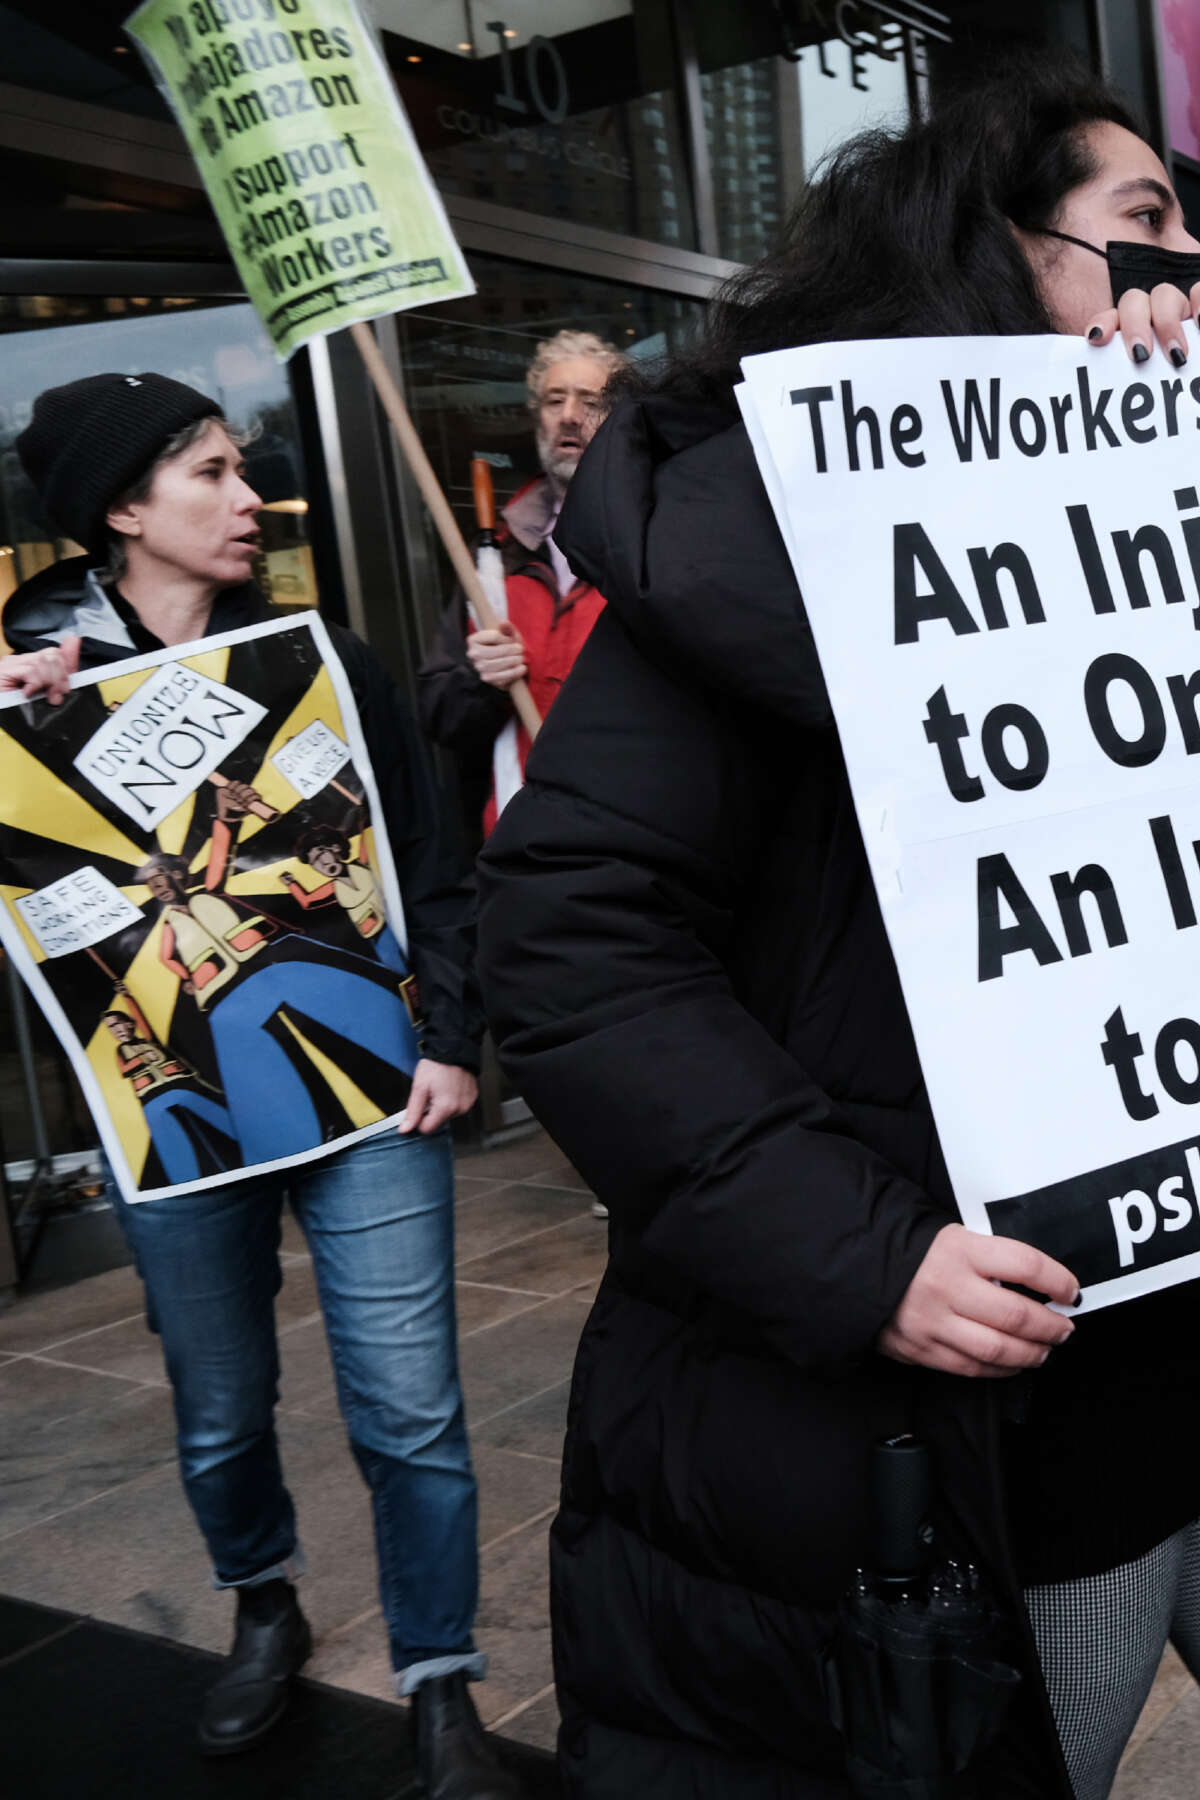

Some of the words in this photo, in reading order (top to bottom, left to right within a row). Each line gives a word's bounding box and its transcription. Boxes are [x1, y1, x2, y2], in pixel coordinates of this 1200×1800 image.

[180, 26, 353, 104] ajadores
[216, 74, 361, 139] Amazon
[486, 20, 569, 124] 10
[231, 132, 366, 205] support
[239, 180, 378, 258] Amazon
[261, 226, 392, 298] Workers
[789, 379, 927, 473] The
[892, 521, 1048, 646] An
[91, 670, 199, 777] UNIONIZE
[120, 690, 246, 815] NOW
[921, 684, 1051, 804] to
[24, 874, 98, 918] SAFE
[42, 902, 132, 952] CONDTIONS
[976, 851, 1130, 983] An
